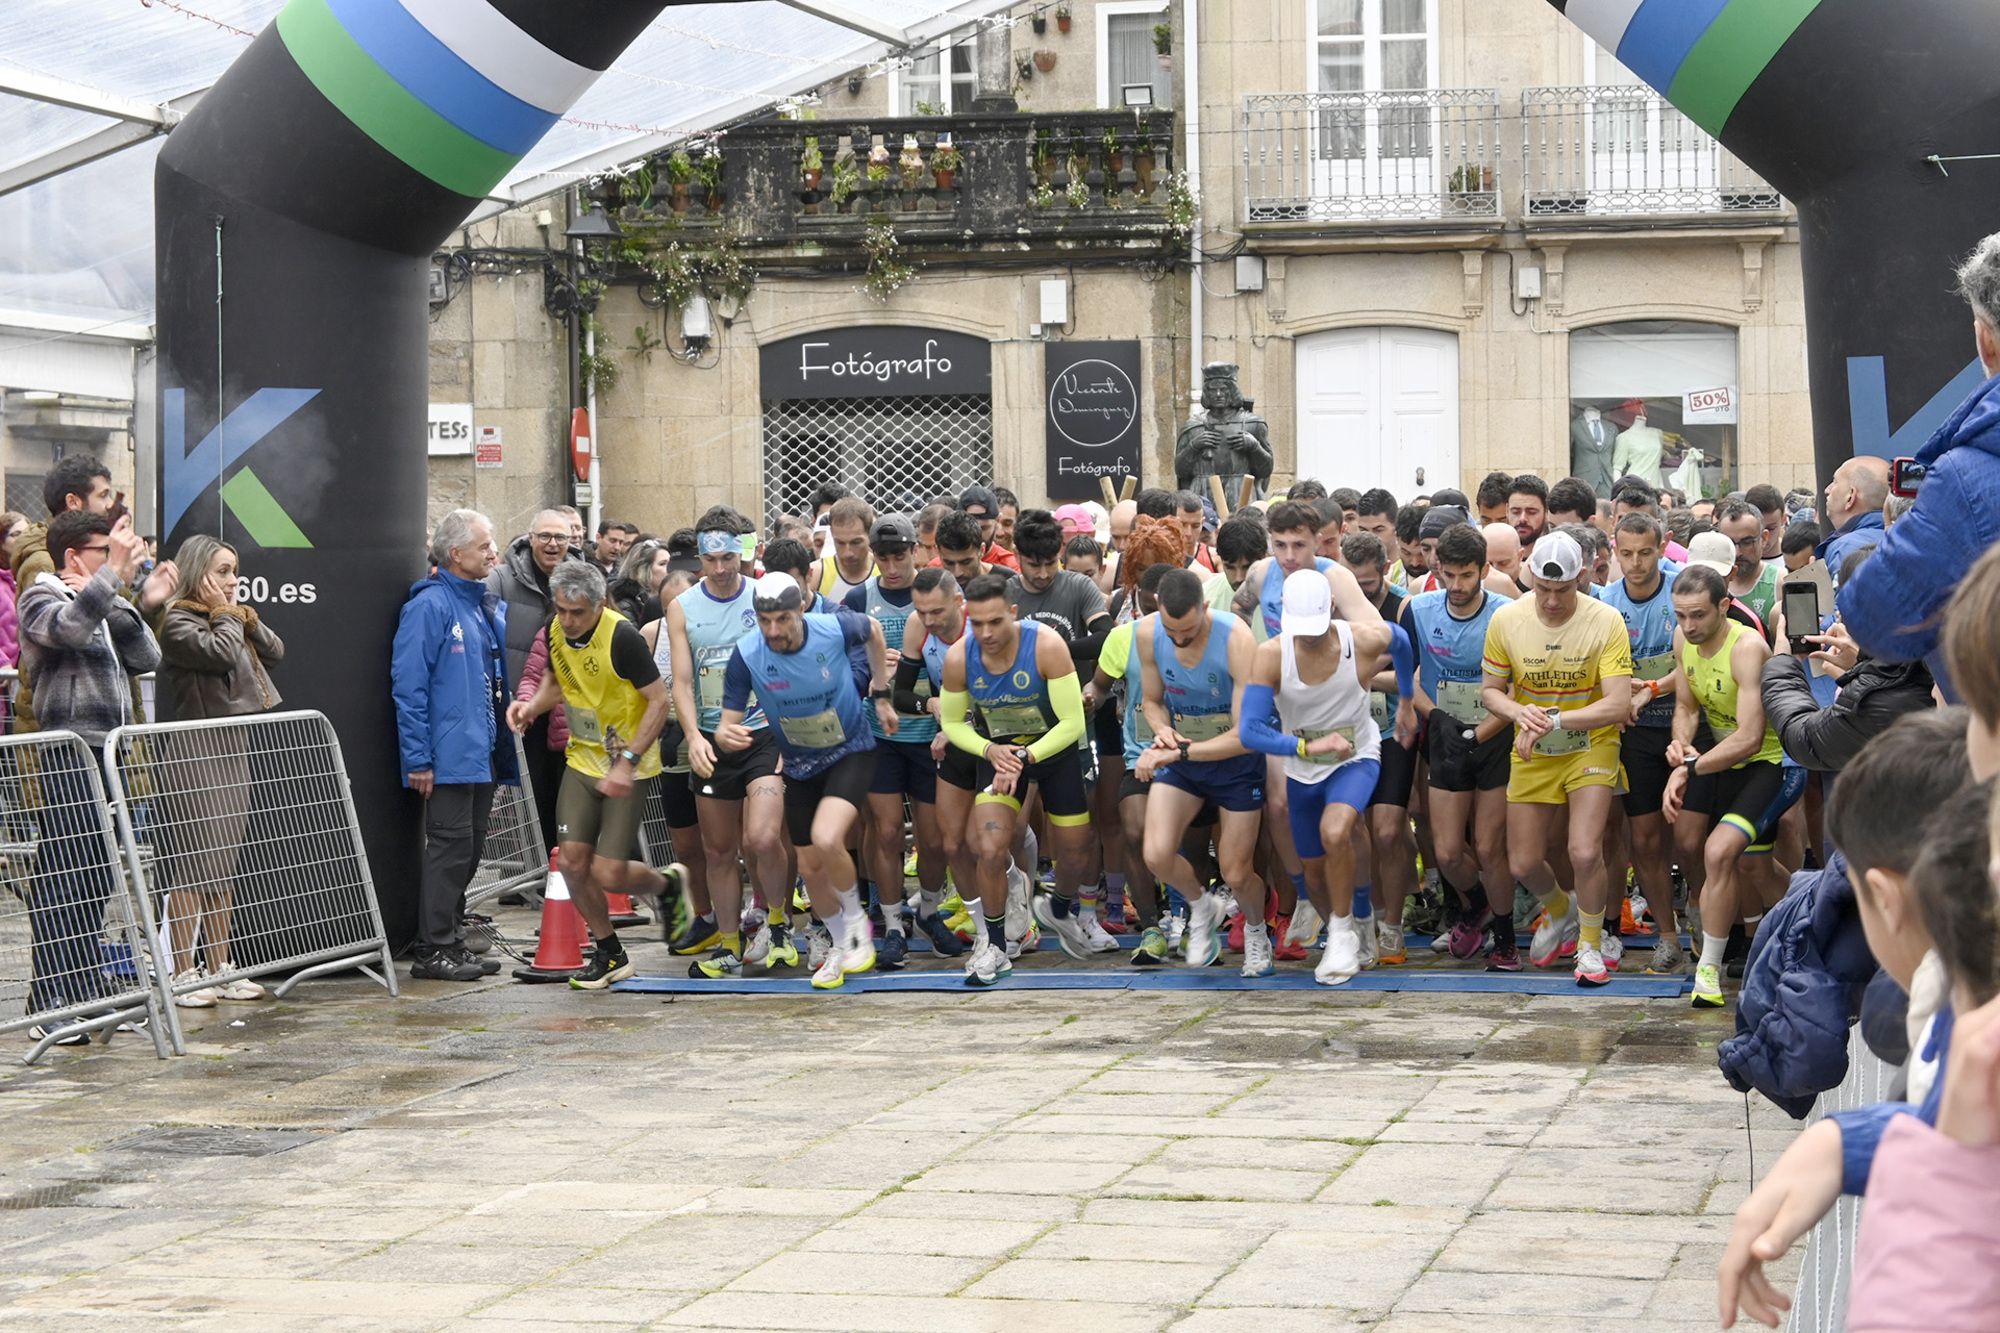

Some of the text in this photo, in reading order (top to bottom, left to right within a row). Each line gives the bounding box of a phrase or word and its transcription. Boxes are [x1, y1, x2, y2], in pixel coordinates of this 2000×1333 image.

[799, 338, 952, 381] Fotógrafo
[1063, 374, 1122, 395] Vicente
[1693, 391, 1727, 408] 50%
[1058, 456, 1131, 477] Fotógrafo
[1523, 669, 1587, 681] ATHLETICS
[1532, 679, 1577, 688] San Lázaro
[1566, 730, 1588, 740] 549
